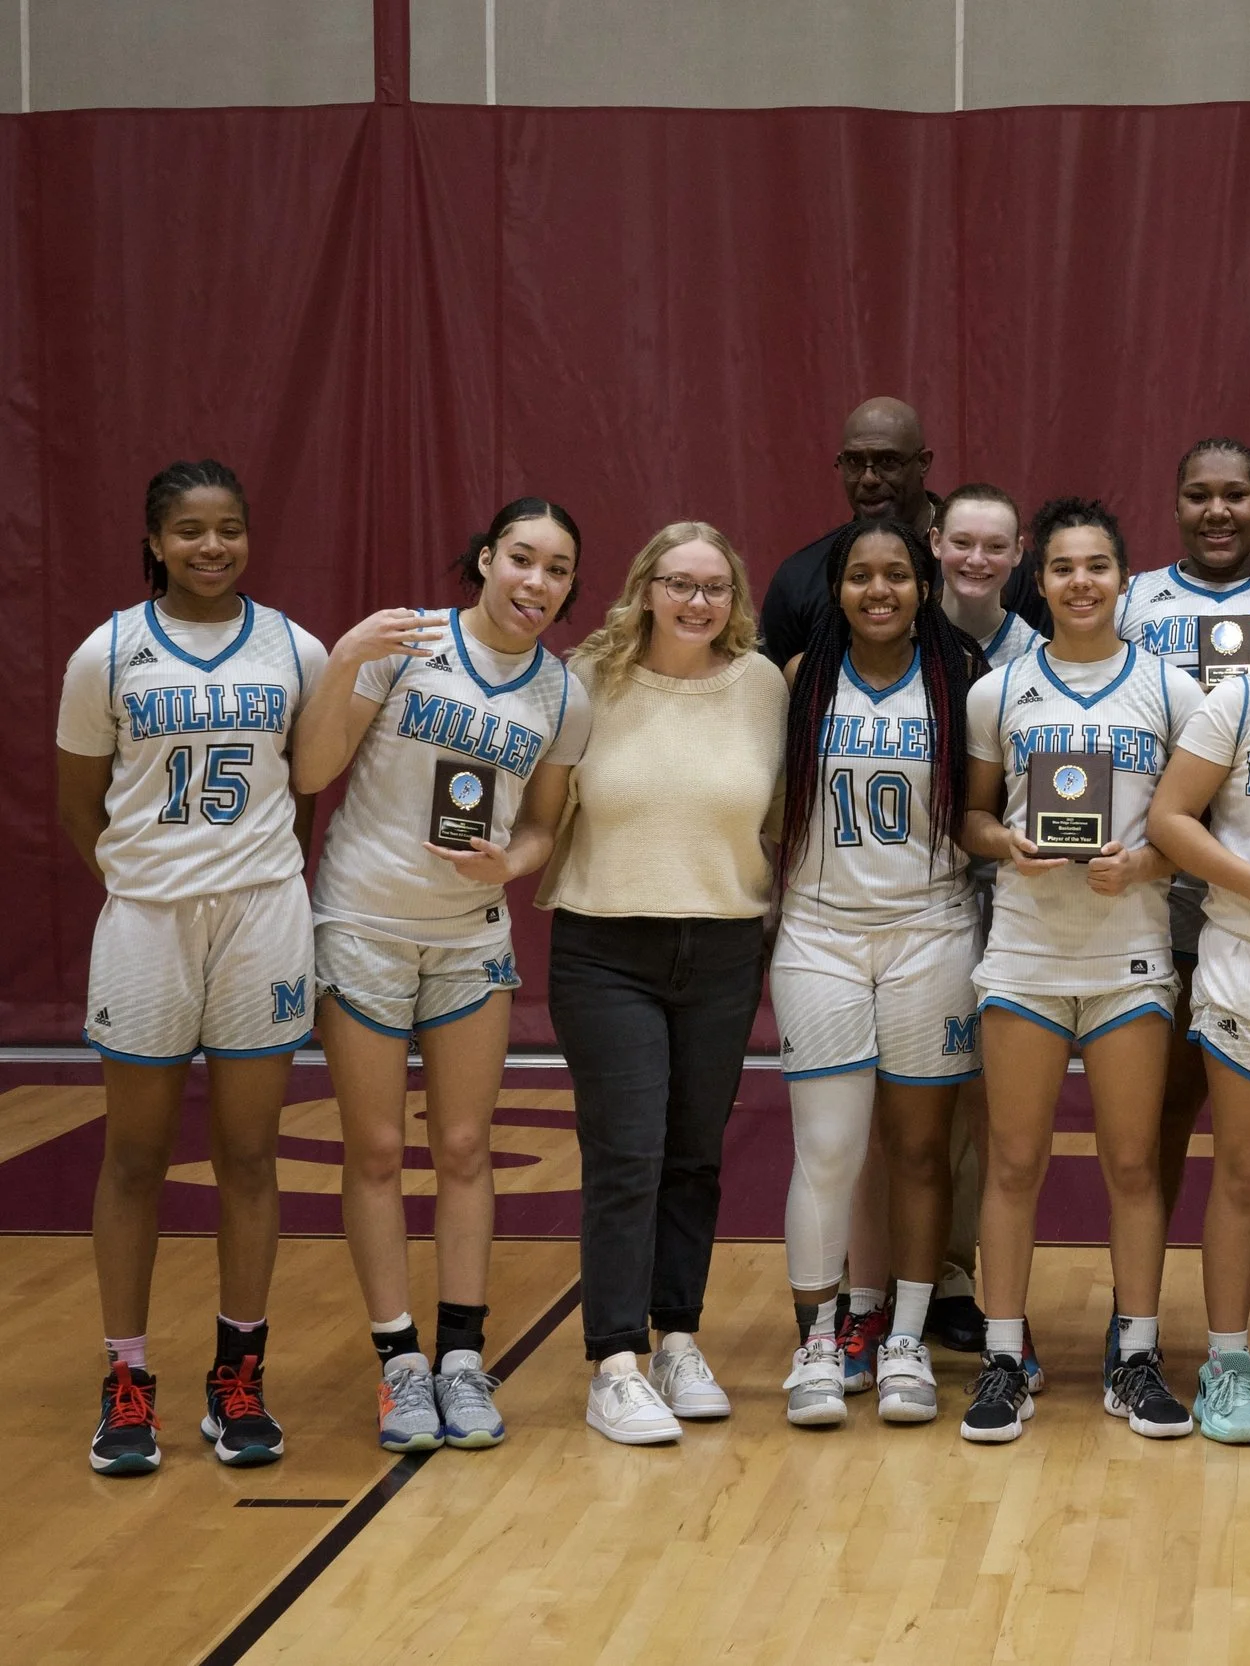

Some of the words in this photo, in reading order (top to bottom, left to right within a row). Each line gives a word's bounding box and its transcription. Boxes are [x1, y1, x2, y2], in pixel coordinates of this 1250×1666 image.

[129, 656, 159, 667] adidas
[425, 660, 453, 673] adidas
[123, 683, 288, 742] MILLER
[1017, 695, 1044, 706] adidas
[397, 688, 545, 780] MILLER
[158, 743, 254, 826] 15
[829, 768, 913, 848] 10
[271, 974, 306, 1024] M
[942, 1013, 981, 1056] M
